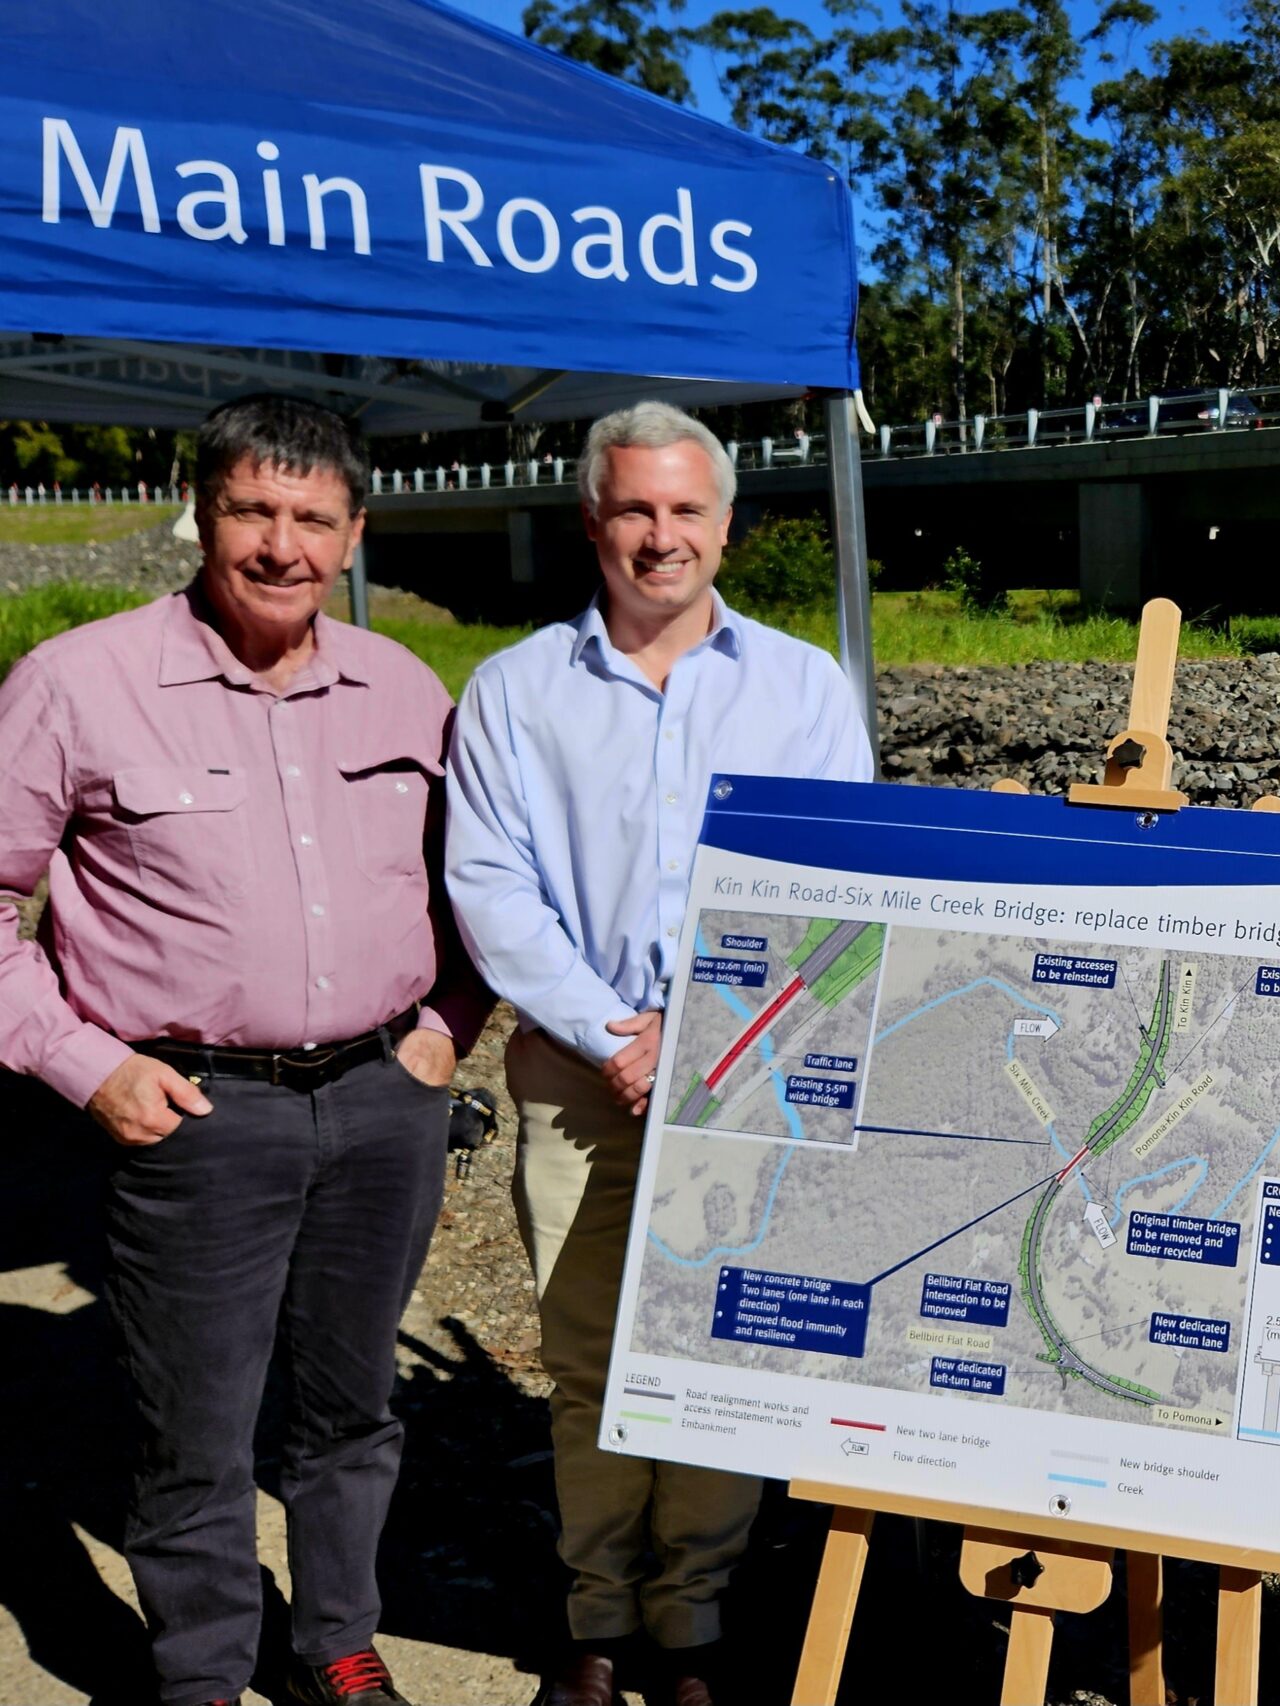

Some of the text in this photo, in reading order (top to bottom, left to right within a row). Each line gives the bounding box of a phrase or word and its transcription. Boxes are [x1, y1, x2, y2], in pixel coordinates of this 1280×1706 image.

[42, 117, 758, 292] Main Roads
[714, 877, 742, 894] Kin
[751, 880, 779, 897] Kin
[789, 882, 872, 906] Road-Six
[881, 890, 921, 910] Mile
[930, 894, 984, 916] Creek
[994, 899, 1065, 926] Bridge:
[1074, 908, 1148, 931] replace
[1158, 913, 1226, 937] timber
[1037, 955, 1114, 972] Existing accesses
[1036, 969, 1109, 984] to be reinstated
[1260, 982, 1270, 992] to
[1178, 980, 1192, 1028] To Kin Kin
[1020, 1023, 1040, 1033] FLOW
[807, 1055, 853, 1069] Traffic lane
[789, 1077, 848, 1094] Existing 5.5m
[789, 1091, 839, 1106] wide bridge
[1135, 1075, 1213, 1155] Pomona-Kin Kin Road
[1132, 1213, 1237, 1236] Original timber bridge
[1131, 1228, 1223, 1248] to be removed and
[1130, 1241, 1203, 1259] timber recycled
[743, 1270, 831, 1292] New concrete bridge
[927, 1274, 1009, 1295] Bellbird Flat Road
[742, 1283, 864, 1309] Two lanes (one lane in each
[925, 1288, 1006, 1308] intersection to be
[739, 1298, 780, 1313] direction)
[924, 1302, 967, 1317] improved
[737, 1311, 847, 1336] Improved flood immunity
[1155, 1316, 1227, 1335] New dedicated
[735, 1326, 796, 1342] and resilience
[1154, 1330, 1223, 1348] right-turn lane
[934, 1358, 1002, 1377] New dedicated
[625, 1373, 661, 1387] LEGEND
[933, 1372, 992, 1389] left-turn lane
[685, 1388, 809, 1415] Road realignment works and
[681, 1417, 736, 1435] Embankment
[1158, 1409, 1212, 1425] To Pomona
[896, 1425, 990, 1448] New two lane bridge
[893, 1450, 956, 1468] Flow direction
[1120, 1457, 1219, 1481] New bridge shoulder
[1117, 1482, 1143, 1495] Creek
